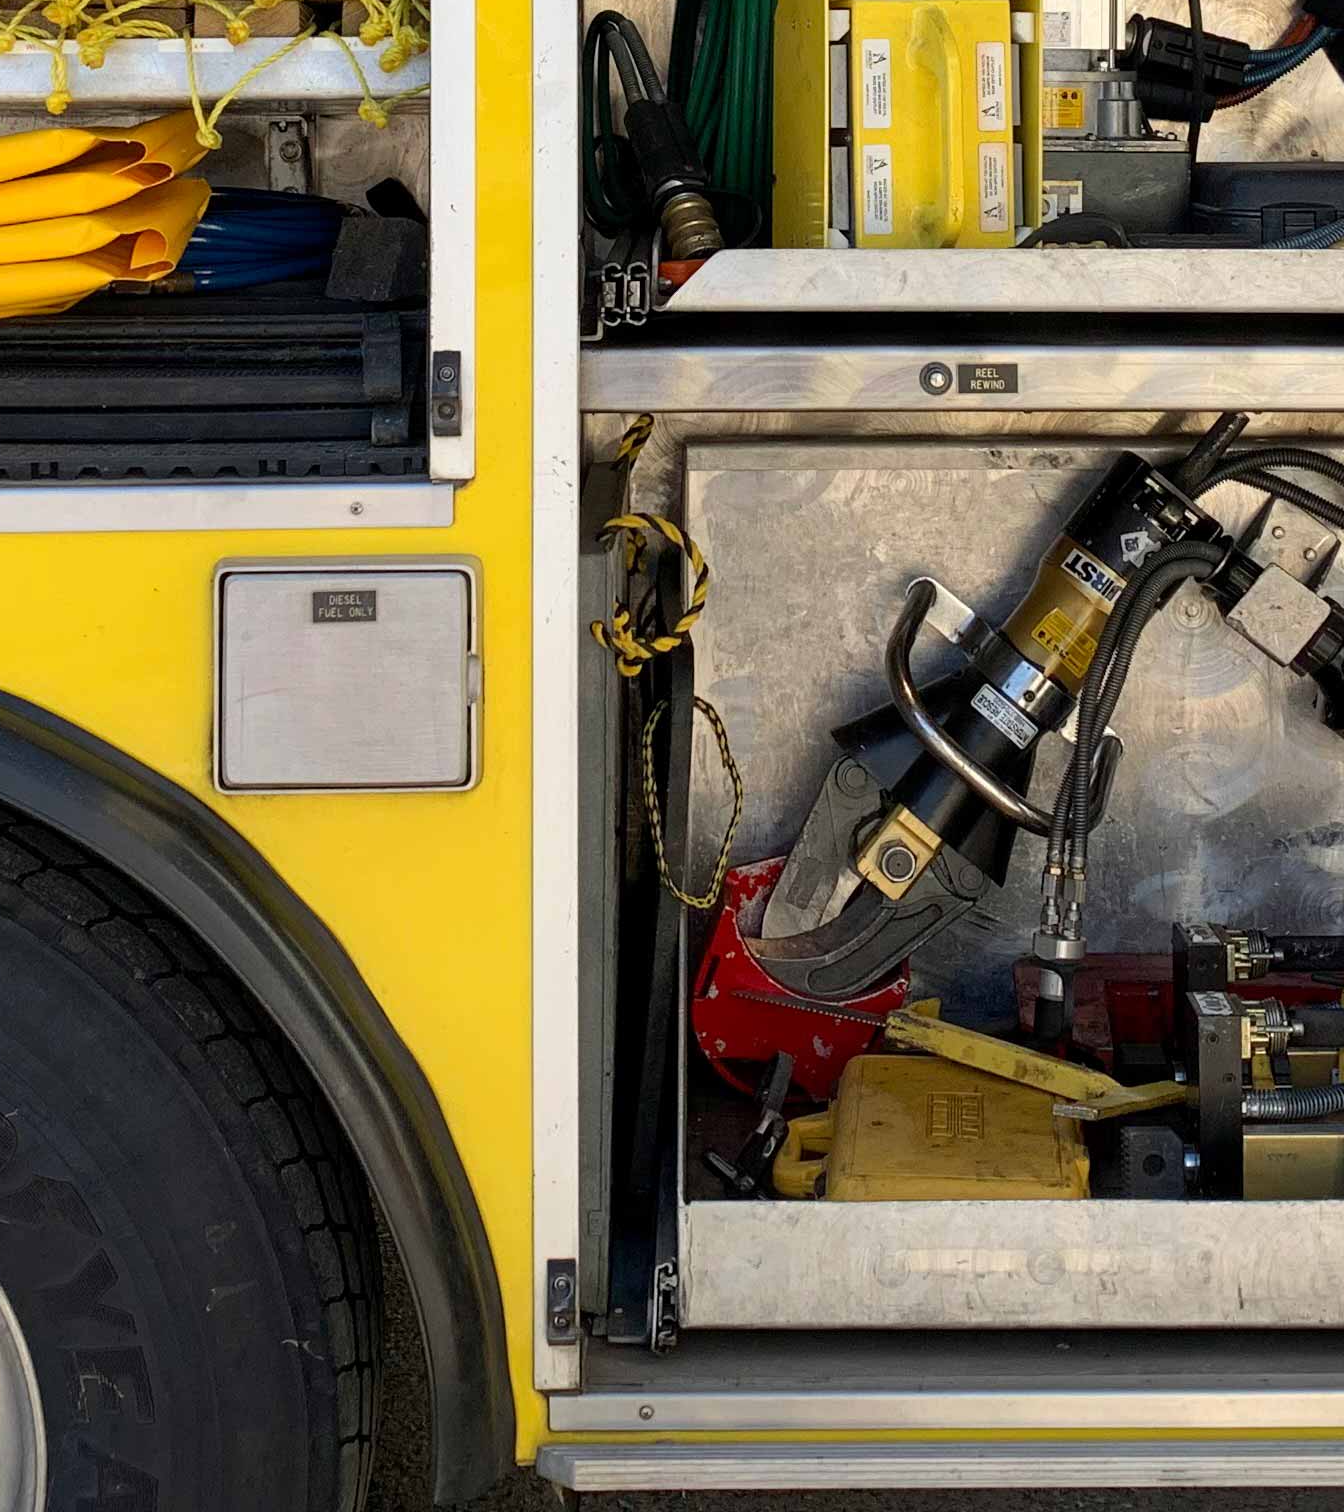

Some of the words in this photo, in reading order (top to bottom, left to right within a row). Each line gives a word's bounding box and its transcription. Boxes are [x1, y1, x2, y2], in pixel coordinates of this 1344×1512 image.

[975, 367, 999, 378] REEL
[970, 379, 1005, 390] REWIND
[328, 594, 362, 605] DIESEL
[318, 607, 343, 618] FUEL
[348, 606, 374, 617] ONLY
